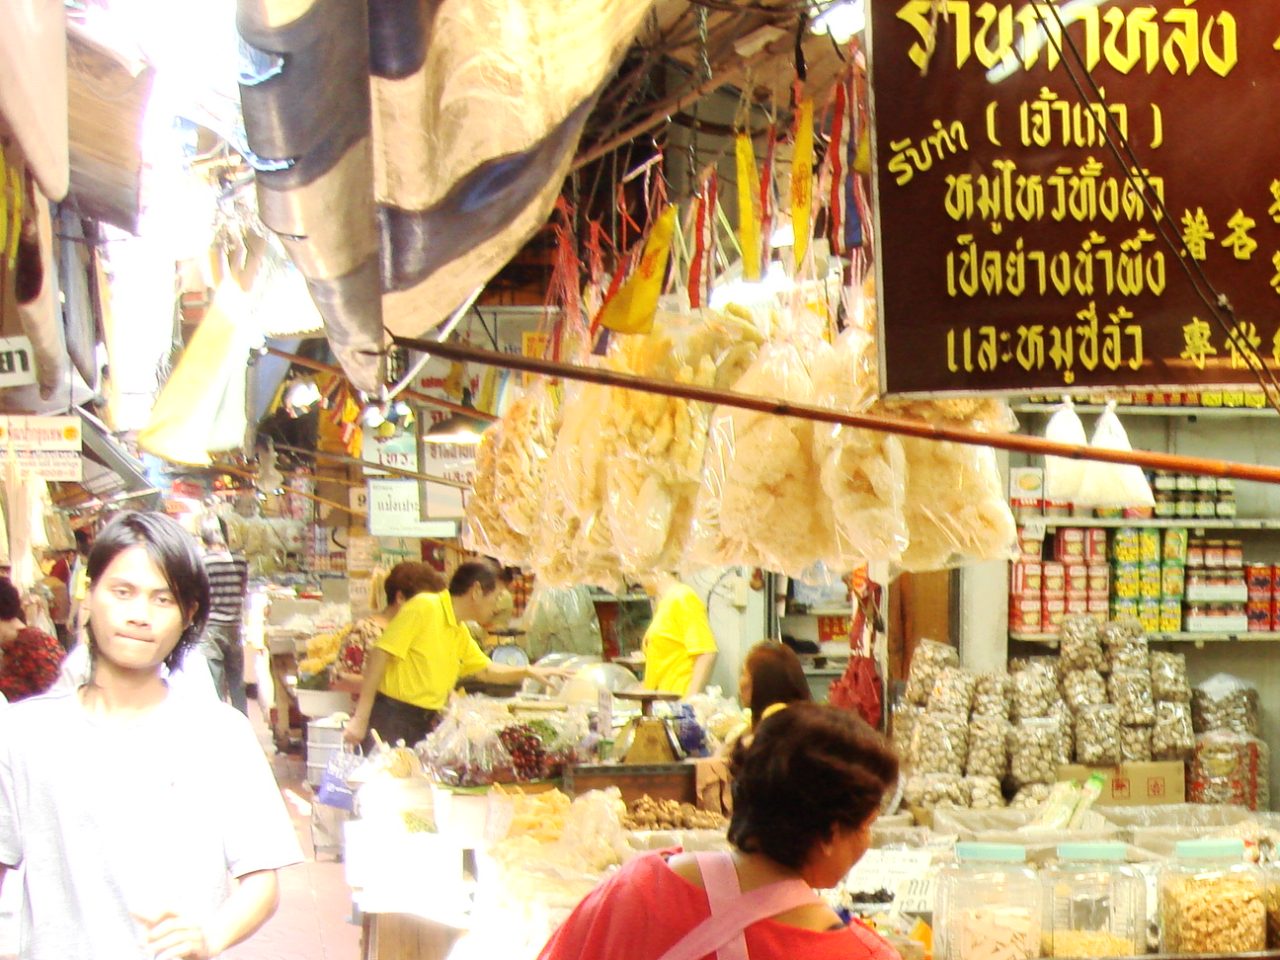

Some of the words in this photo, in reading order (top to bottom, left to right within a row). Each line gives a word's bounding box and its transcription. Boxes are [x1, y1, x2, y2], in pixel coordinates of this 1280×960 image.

[946, 228, 1167, 297] เป็ดย่างน้ำผึ้ง
